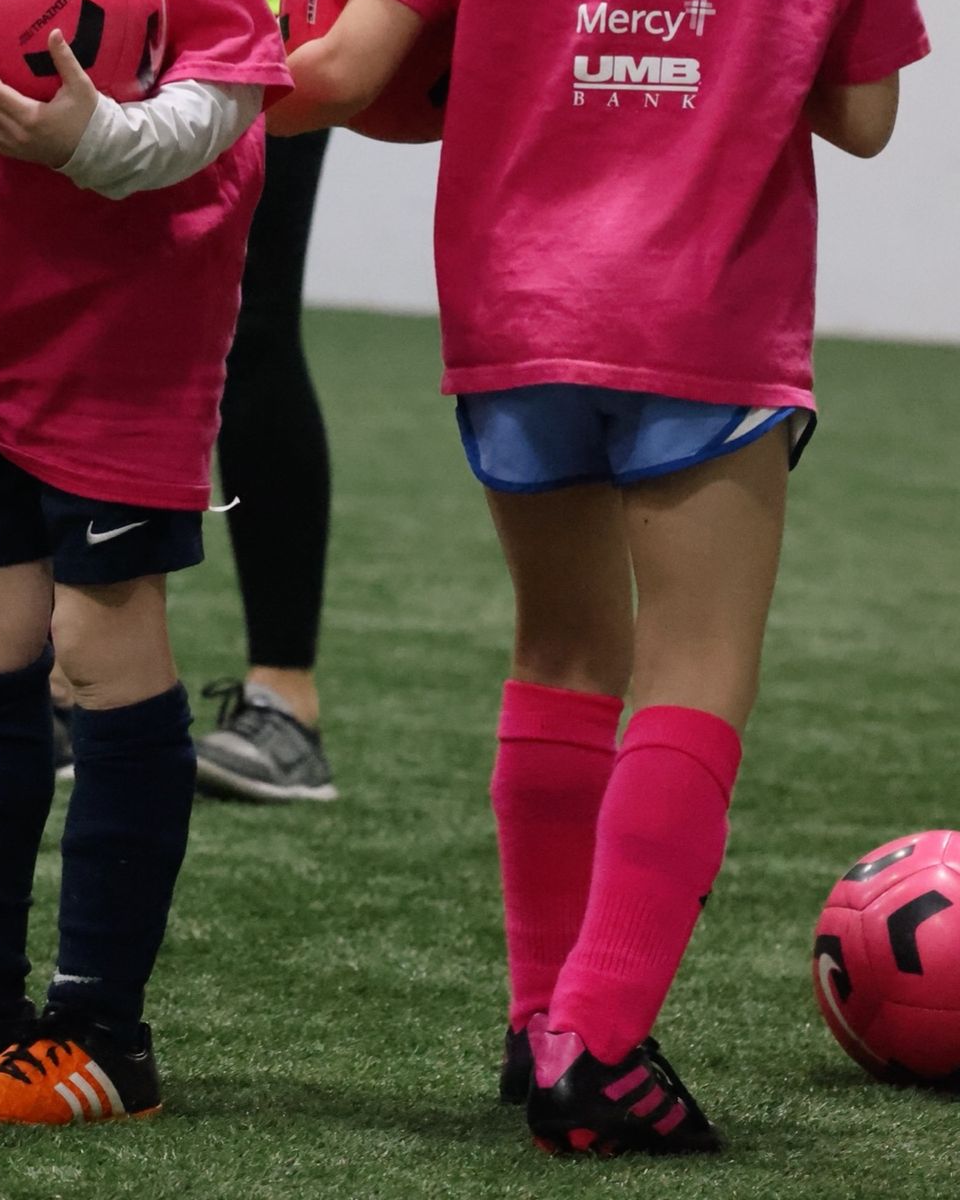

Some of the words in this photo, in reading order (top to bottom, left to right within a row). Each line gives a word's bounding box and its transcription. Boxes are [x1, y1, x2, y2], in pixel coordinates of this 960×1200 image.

[576, 2, 686, 42] Mercy
[573, 56, 702, 85] UMB
[573, 91, 696, 110] BANK
